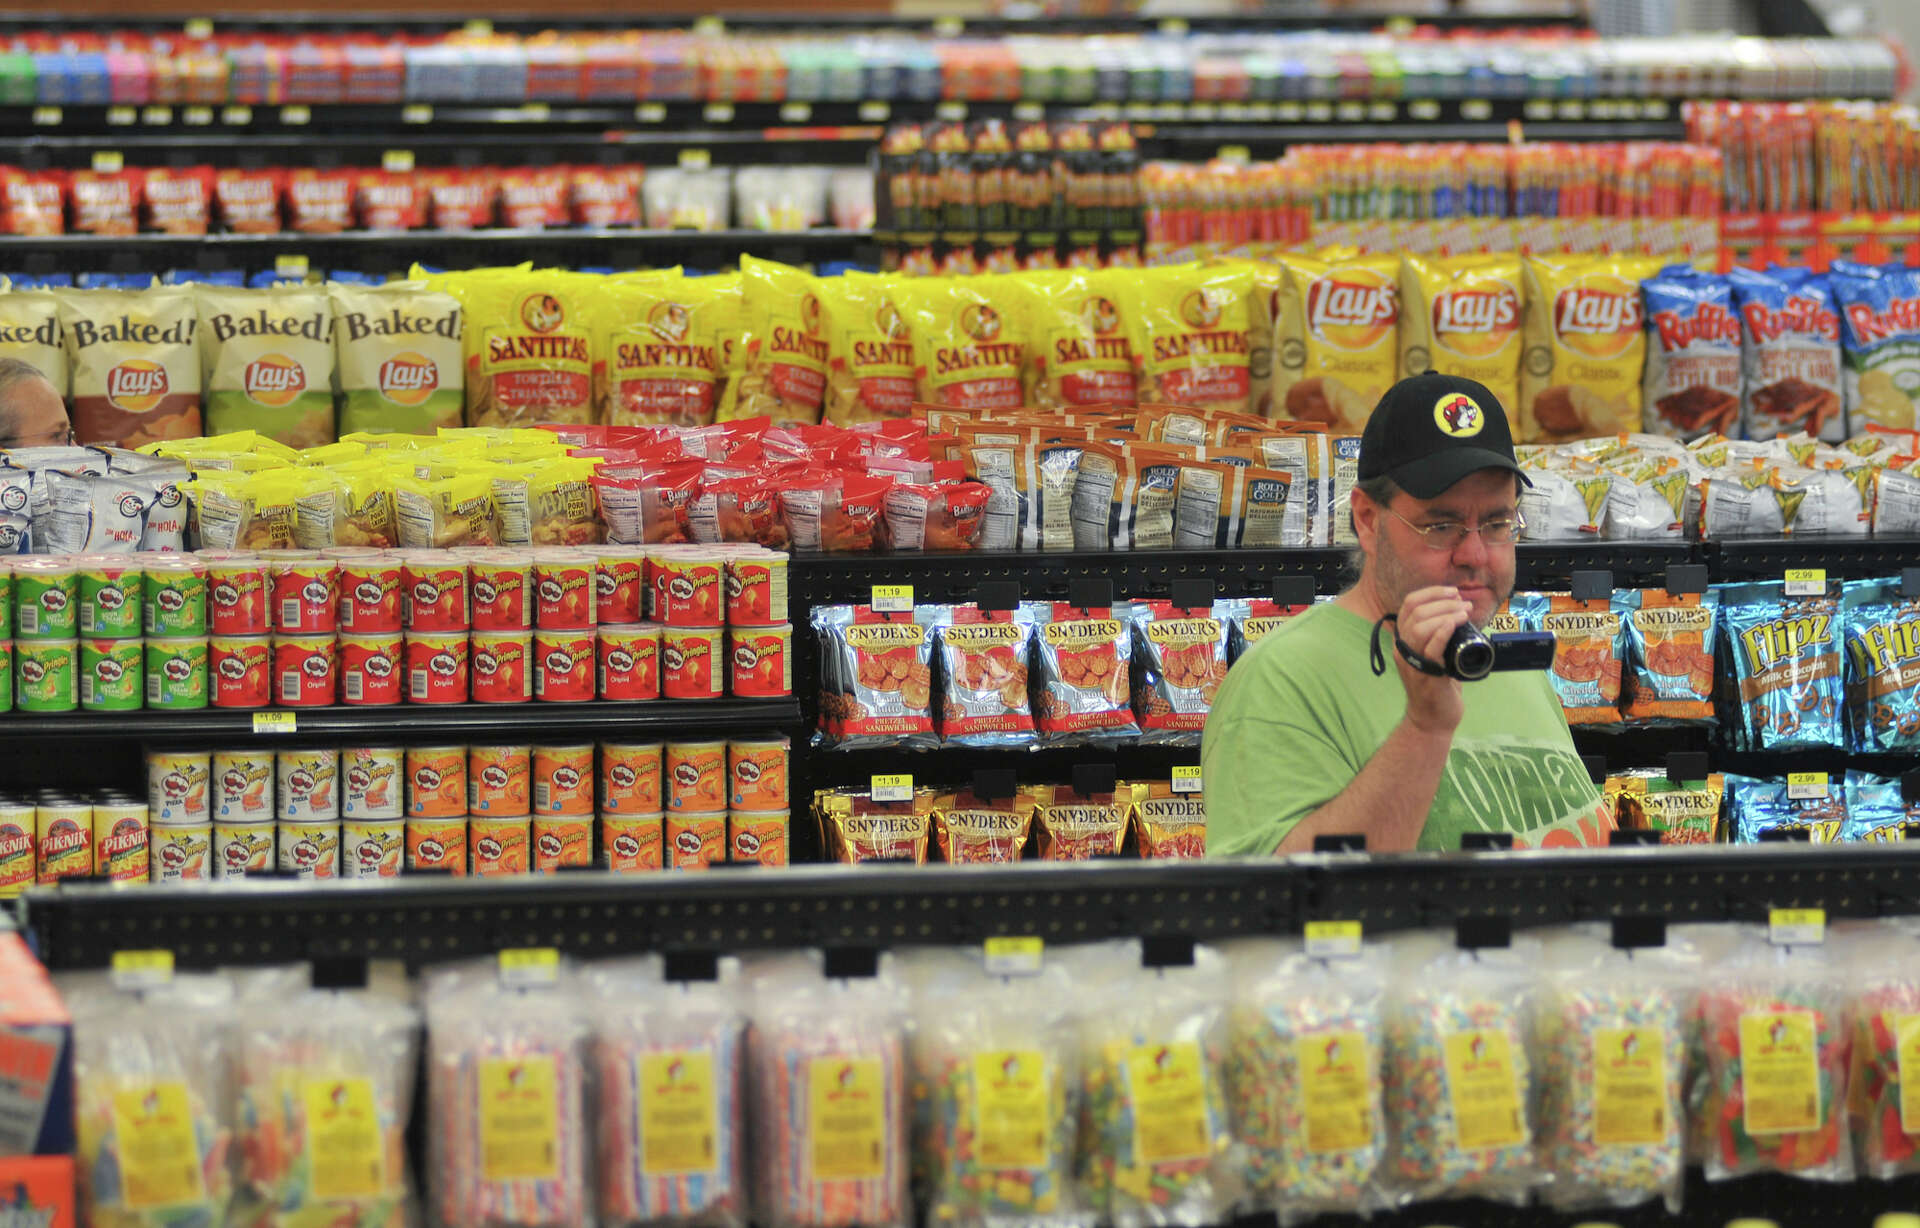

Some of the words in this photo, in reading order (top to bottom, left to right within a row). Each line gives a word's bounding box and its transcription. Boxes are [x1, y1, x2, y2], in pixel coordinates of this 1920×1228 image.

[1313, 280, 1397, 326] Lay's
[1437, 294, 1516, 333] Lay's
[1559, 291, 1641, 333] Lay's
[1741, 295, 1841, 345] Ruffles
[211, 309, 335, 345] Baked!
[1847, 297, 1920, 346] Ruffl
[0, 317, 65, 349] ked!
[73, 314, 197, 349] Baked!
[489, 335, 589, 364] SANTITAS
[770, 326, 829, 363] SANTIT
[854, 340, 915, 368] SANTIT
[111, 367, 165, 397] Lay's
[249, 361, 302, 392] Lay's
[382, 361, 436, 390] Lay's
[1340, 439, 1361, 448] ROL
[1151, 467, 1175, 477] ROLD
[1147, 475, 1175, 488] GOLD
[1257, 481, 1285, 492] ROLD
[1253, 489, 1286, 501] GOLD
[567, 502, 585, 510] PORK
[568, 509, 586, 518] SKINS
[270, 525, 289, 533] PORK
[271, 532, 290, 540] SKINS
[1546, 615, 1615, 631] SNYDER'S
[1637, 606, 1706, 625] SNYDER'S
[849, 626, 919, 640] SNYDER'S
[948, 626, 1019, 641] SNYDER'S
[1049, 622, 1118, 639] SNYDER'S
[1151, 622, 1218, 637] SNYDER'S
[1740, 613, 1832, 677] Flipz
[1859, 618, 1920, 677] Flip
[1654, 679, 1694, 690] Cheddar
[1761, 671, 1783, 686] Milk
[1562, 685, 1604, 696] Cheddar
[1658, 689, 1692, 699] Cheese
[1566, 695, 1601, 705] Cheese
[865, 723, 918, 732] SANDWICHES
[875, 717, 905, 725] PRETZEL
[964, 723, 1017, 732] SANDWICHES
[973, 717, 1004, 725] PRETZEL
[1165, 719, 1205, 729] SANDWIC
[1145, 801, 1207, 817] SNYDER
[1643, 793, 1714, 809] SNYDER'S
[949, 813, 1019, 830] SNYDER'S
[1048, 808, 1119, 824] SNYDER'S
[1170, 814, 1203, 822] HANOVER
[848, 816, 920, 833] SNYDER'S
